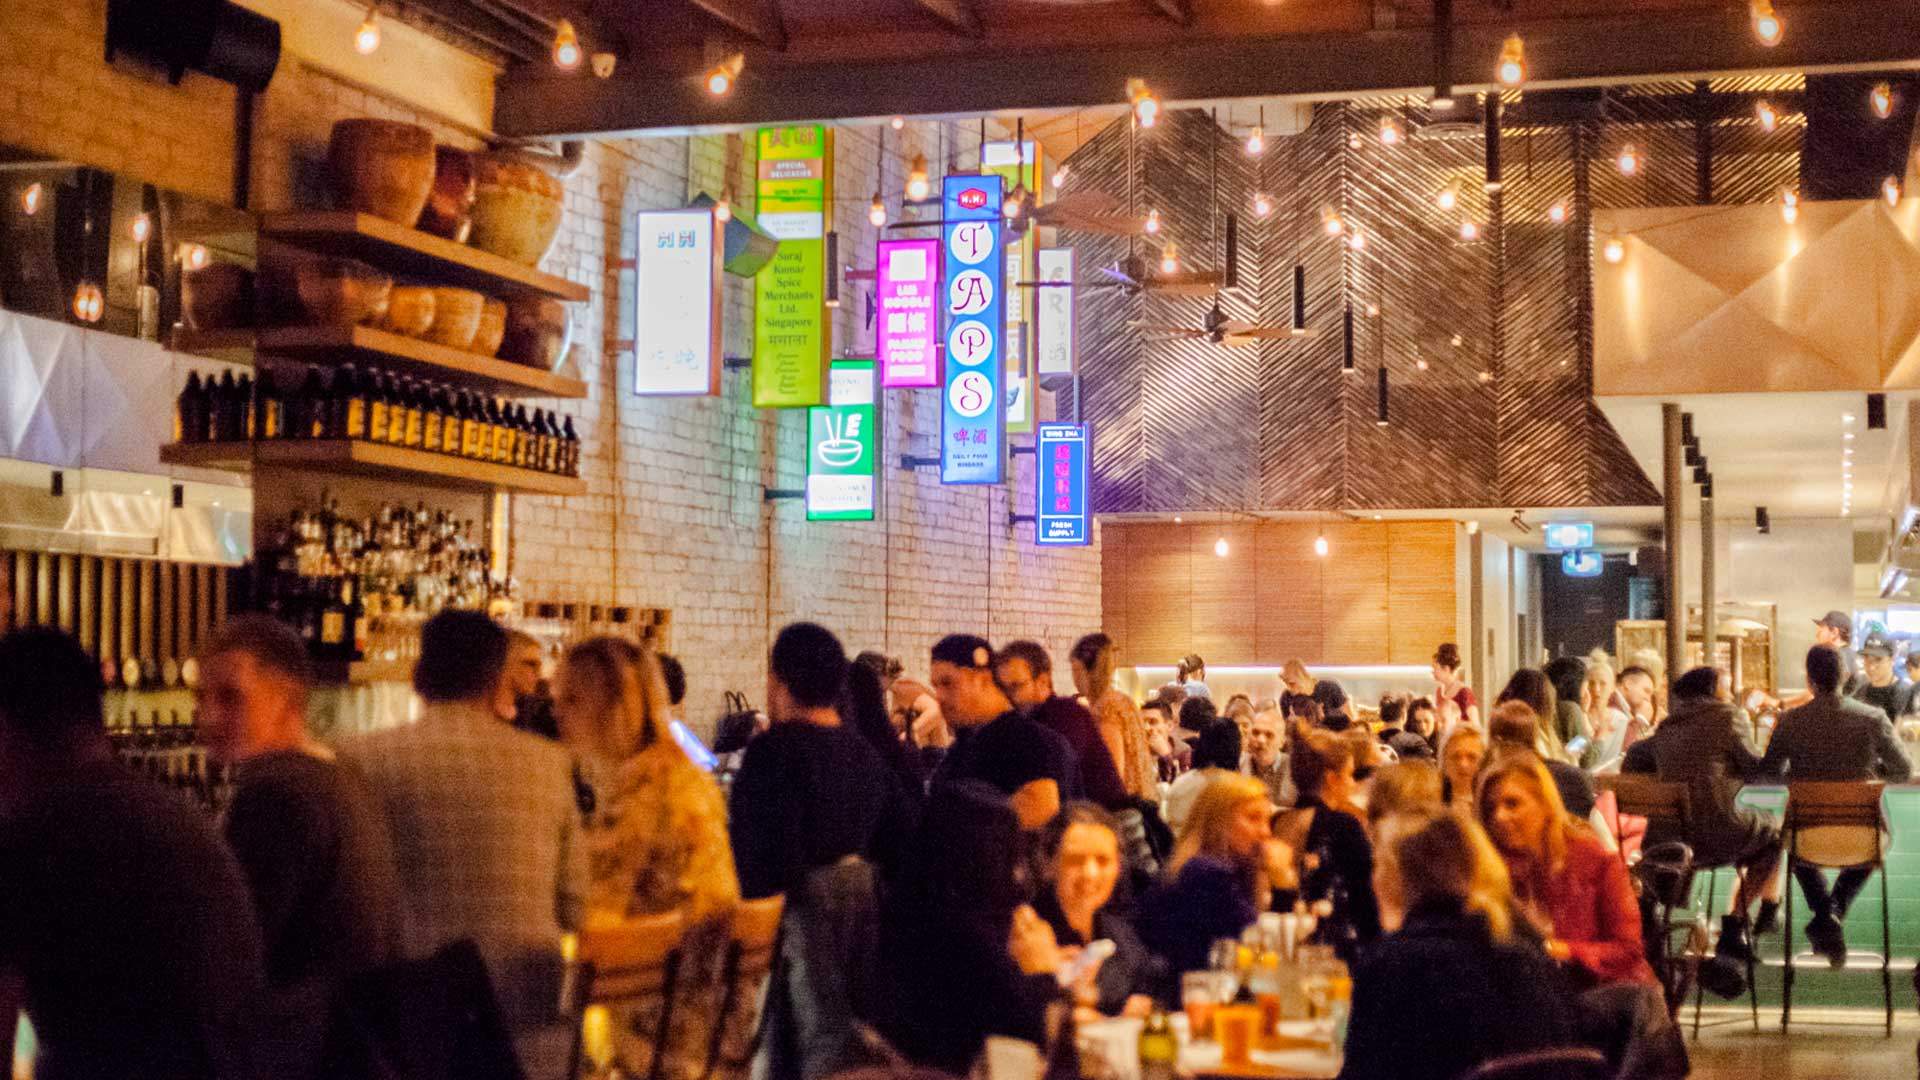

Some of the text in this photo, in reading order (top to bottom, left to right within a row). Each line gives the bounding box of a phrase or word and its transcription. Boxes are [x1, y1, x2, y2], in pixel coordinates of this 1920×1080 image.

[777, 253, 802, 262] Suraj
[774, 266, 805, 274] Kumar
[777, 278, 801, 288] Spice
[765, 291, 814, 300] Merchants
[779, 304, 799, 313] Ltd.
[953, 223, 987, 411] TAPS
[765, 318, 812, 329] Singapore
